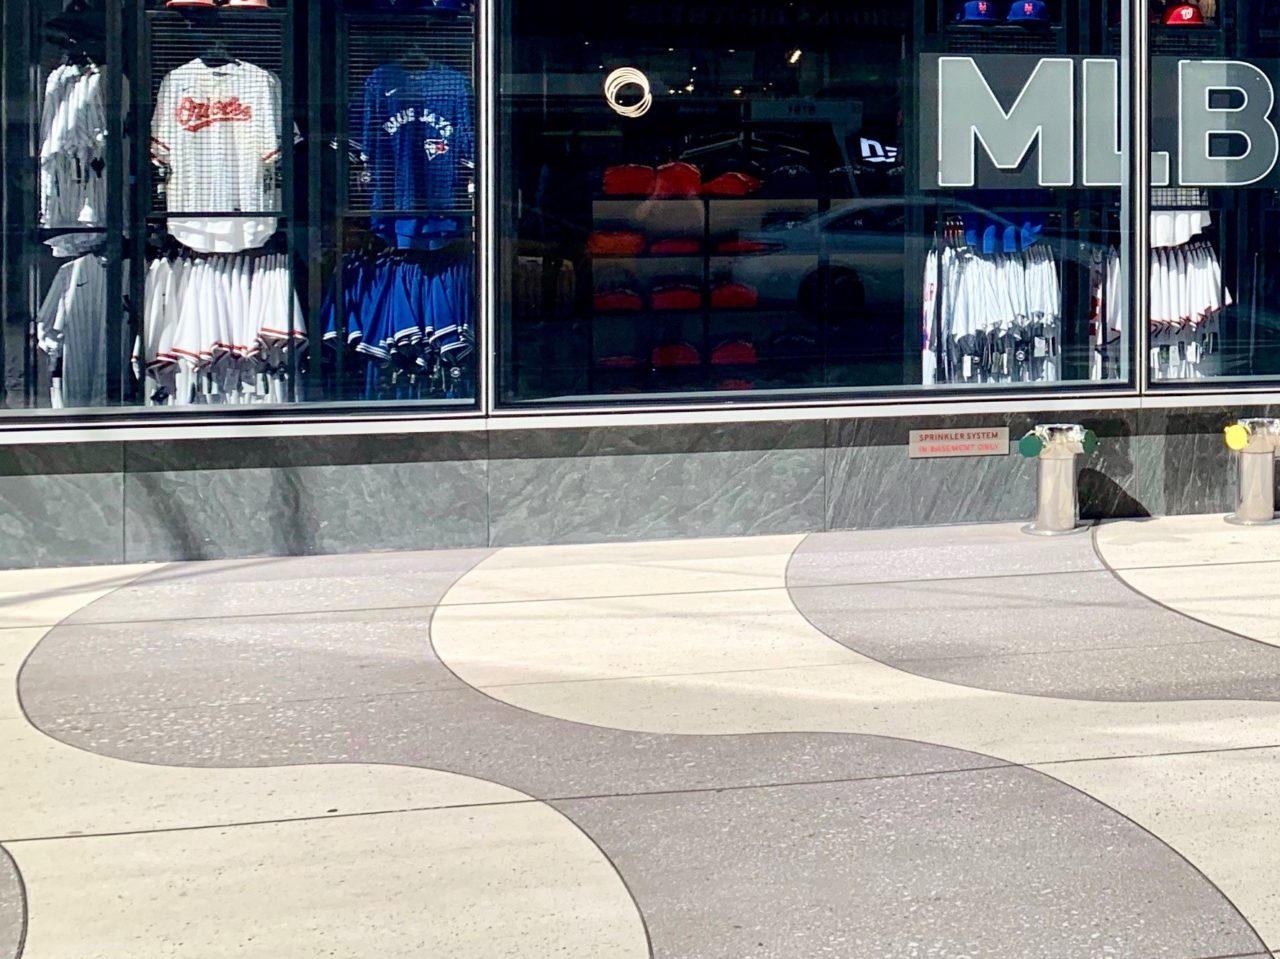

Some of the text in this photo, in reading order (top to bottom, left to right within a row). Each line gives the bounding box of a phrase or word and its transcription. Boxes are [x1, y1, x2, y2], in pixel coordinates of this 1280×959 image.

[1181, 7, 1194, 21] W
[938, 56, 1278, 187] MLB
[919, 431, 998, 441] SPRINKLER SYSTEM
